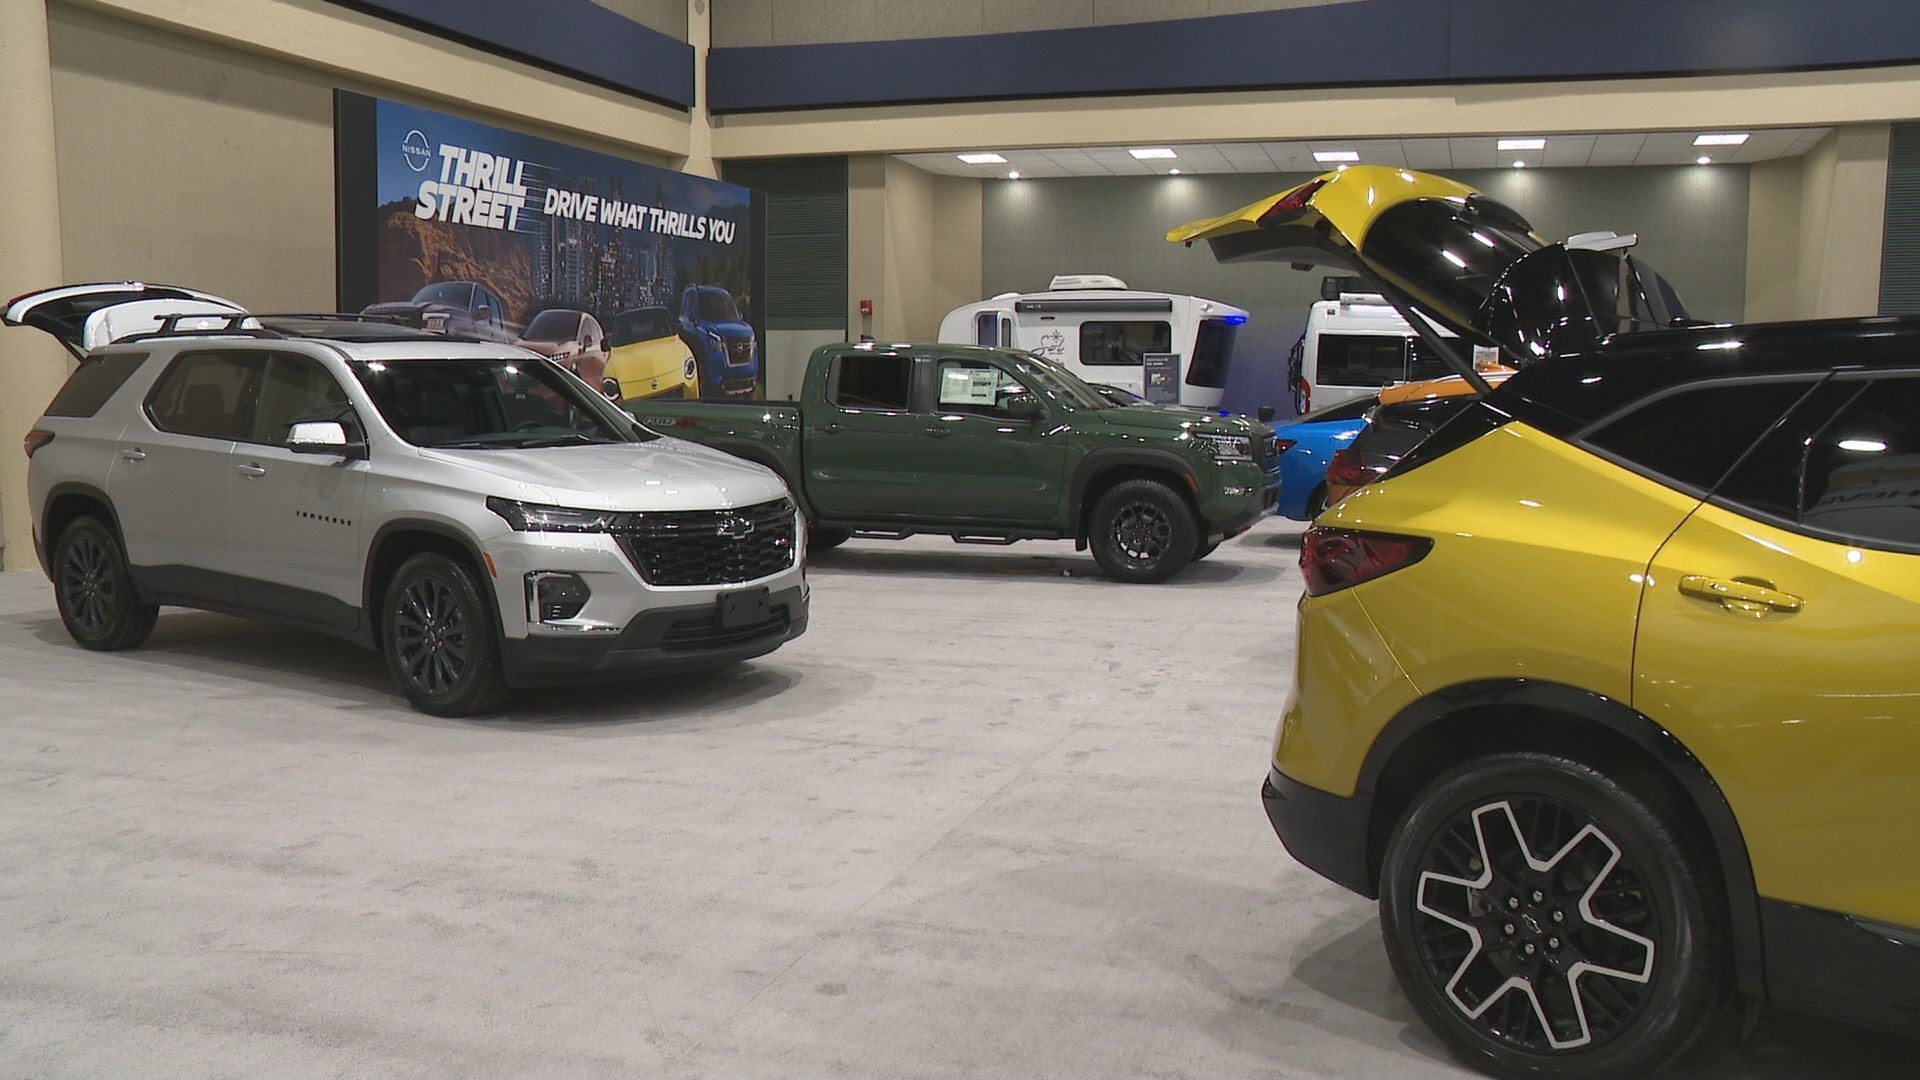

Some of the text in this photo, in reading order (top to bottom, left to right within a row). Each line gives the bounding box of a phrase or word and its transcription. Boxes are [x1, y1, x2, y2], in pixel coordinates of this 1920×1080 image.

[402, 144, 431, 157] NISSAN
[439, 143, 527, 197] THRILL
[415, 180, 527, 232] STREET
[543, 187, 737, 245] DRIVE WHAT THRILLS YOU
[296, 510, 352, 526] TRAVERSE
